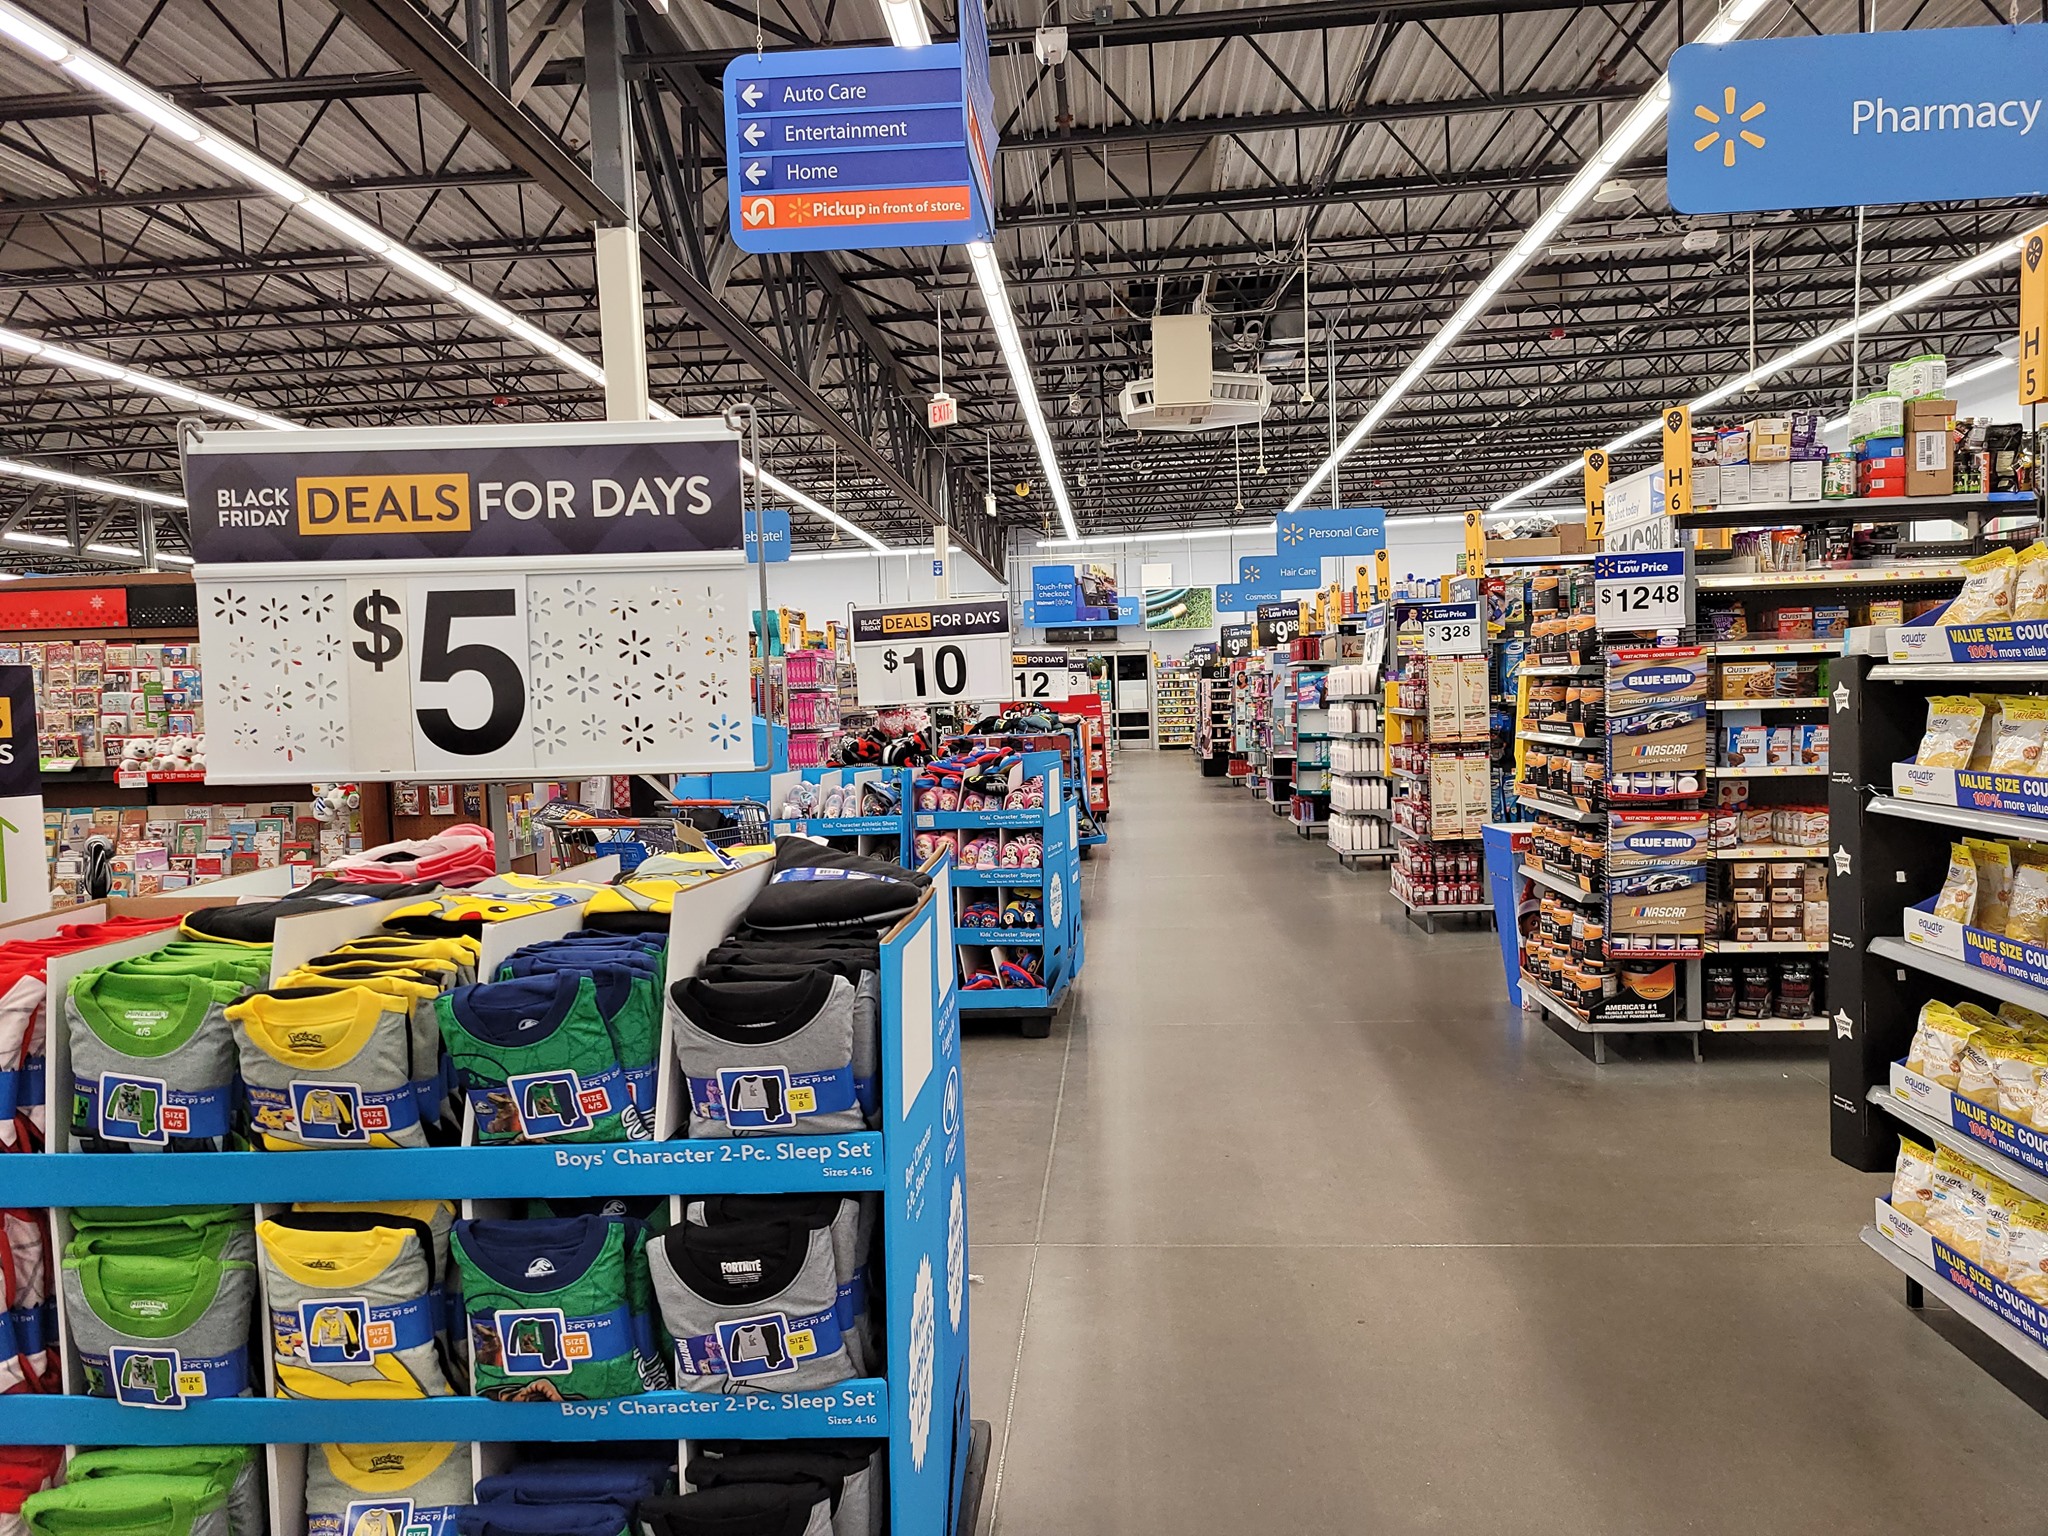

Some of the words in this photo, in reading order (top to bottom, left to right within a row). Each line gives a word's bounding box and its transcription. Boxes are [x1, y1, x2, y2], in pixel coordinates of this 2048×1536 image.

[783, 86, 824, 103] Auto
[828, 83, 867, 101] Care
[1853, 98, 2042, 136] Pharmacy
[785, 121, 907, 142] Entertainment
[787, 163, 838, 180] Home
[813, 200, 866, 218] Pickup
[868, 204, 880, 214] in
[883, 202, 913, 214] front
[915, 201, 928, 212] of
[930, 201, 965, 213] store.
[2025, 326, 2040, 359] H
[2026, 368, 2036, 396] 5
[932, 403, 950, 423] EXIT
[1669, 468, 1682, 487] H
[217, 487, 289, 509] BLACK
[308, 484, 460, 524] DEALS
[478, 480, 576, 522] FOR
[593, 476, 713, 518] DAYS
[1672, 493, 1680, 510] 6
[1592, 501, 1604, 516] H
[218, 508, 290, 528] FRIDAY
[1309, 527, 1352, 539] Personal
[1355, 526, 1379, 537] Care
[1594, 522, 1603, 536] 7
[1468, 549, 1476, 561] H
[1280, 568, 1296, 577] Hair
[1298, 567, 1316, 576] Care
[1470, 565, 1475, 576] 8
[1618, 564, 1640, 574] Low
[1641, 562, 1668, 573] Price
[1036, 583, 1072, 591] Touch-free
[1379, 577, 1388, 586] H
[1245, 590, 1278, 600] Cosmetics
[1361, 591, 1368, 599] H
[1379, 589, 1389, 598] 10
[1269, 610, 1281, 618] Low
[1282, 608, 1298, 616] Price
[1434, 611, 1449, 619] Low
[1450, 610, 1467, 618] Price
[885, 616, 928, 630] DEALS
[933, 613, 961, 627] FOR
[965, 611, 1001, 625] DAYS
[1901, 632, 1926, 646] equate
[1950, 628, 1985, 643] VALUE
[1986, 626, 2014, 642] SIZE
[2016, 623, 2048, 640] COU
[1967, 644, 1998, 659] 100%
[1999, 647, 2021, 658] more
[2022, 645, 2046, 657] value
[1013, 656, 1026, 664] ALS
[1028, 656, 1043, 664] FOR
[1044, 655, 1064, 664] DAYS
[1213, 667, 1226, 678] elf
[1014, 671, 1050, 697] 12
[1645, 744, 1688, 756] NASCAR
[1908, 769, 1935, 784] equate
[1958, 773, 1992, 790] VALUE
[1995, 777, 2020, 794] SIZE
[2023, 780, 2048, 797] COU
[1973, 792, 2003, 809] 100%
[2004, 799, 2025, 811] more
[2026, 802, 2048, 814] value
[1020, 813, 1040, 821] Slippers
[836, 821, 860, 829] Character
[861, 820, 880, 828] Athletic
[1020, 872, 1040, 880] Slippers
[1644, 907, 1687, 917] NASCAR
[1918, 918, 1944, 934] equate
[1966, 931, 1997, 953] VALUE
[1999, 938, 2023, 961] SIZE
[2026, 949, 2048, 970] COU
[1980, 952, 2007, 972] 100%
[2008, 965, 2028, 979] more
[2029, 972, 2048, 986] value
[136, 1028, 150, 1036] 4/5
[582, 1079, 602, 1089] 2-PC
[603, 1075, 612, 1084] PJ
[792, 1078, 811, 1086] 2-PC
[811, 1076, 821, 1085] PJ
[823, 1074, 836, 1082] Set
[1905, 1074, 1931, 1094] equate
[168, 1096, 186, 1104] 2-PC
[200, 1095, 215, 1103] Set
[582, 1093, 603, 1104] SIZE
[790, 1092, 810, 1100] SIZE
[588, 1101, 603, 1110] 4/5
[798, 1100, 805, 1108] 8
[165, 1111, 184, 1119] SIZE
[1954, 1097, 1988, 1125] VALUE
[1990, 1117, 2015, 1139] SIZE
[2018, 1129, 2048, 1156] COUG
[1969, 1121, 1998, 1145] 100%
[1999, 1140, 2019, 1157] more
[2021, 1150, 2043, 1169] value
[556, 1150, 606, 1170] Boys'
[613, 1147, 715, 1165] Character
[720, 1144, 771, 1162] 2-Pc.
[777, 1141, 832, 1163] Sleep
[838, 1140, 872, 1157] Set
[823, 1167, 848, 1178] Sizes
[850, 1166, 873, 1177] 4-16
[1889, 1213, 1914, 1236] equate
[720, 1259, 762, 1274] FORTNITE
[1935, 1243, 1967, 1275] VALUE
[1968, 1266, 1993, 1292] SIZE
[1995, 1284, 2036, 1321] COUGH
[839, 1288, 852, 1298] Set
[1950, 1268, 1977, 1296] 100%
[1978, 1291, 1999, 1310] more
[2000, 1305, 2021, 1326] value
[2022, 1319, 2041, 1341] than
[369, 1327, 390, 1336] SIZE
[373, 1336, 388, 1345] 6/7
[566, 1338, 585, 1346] SIZE
[570, 1346, 584, 1354] 6/7
[675, 1338, 696, 1374] FORTNITE
[214, 1360, 229, 1368] Set
[562, 1401, 612, 1419] Boys'
[619, 1397, 719, 1414] Character
[725, 1395, 776, 1412] 2-Pc.
[781, 1392, 836, 1412] Sleep
[843, 1390, 876, 1407] Set
[828, 1416, 852, 1425] Sizes
[854, 1414, 877, 1424] 4-16
